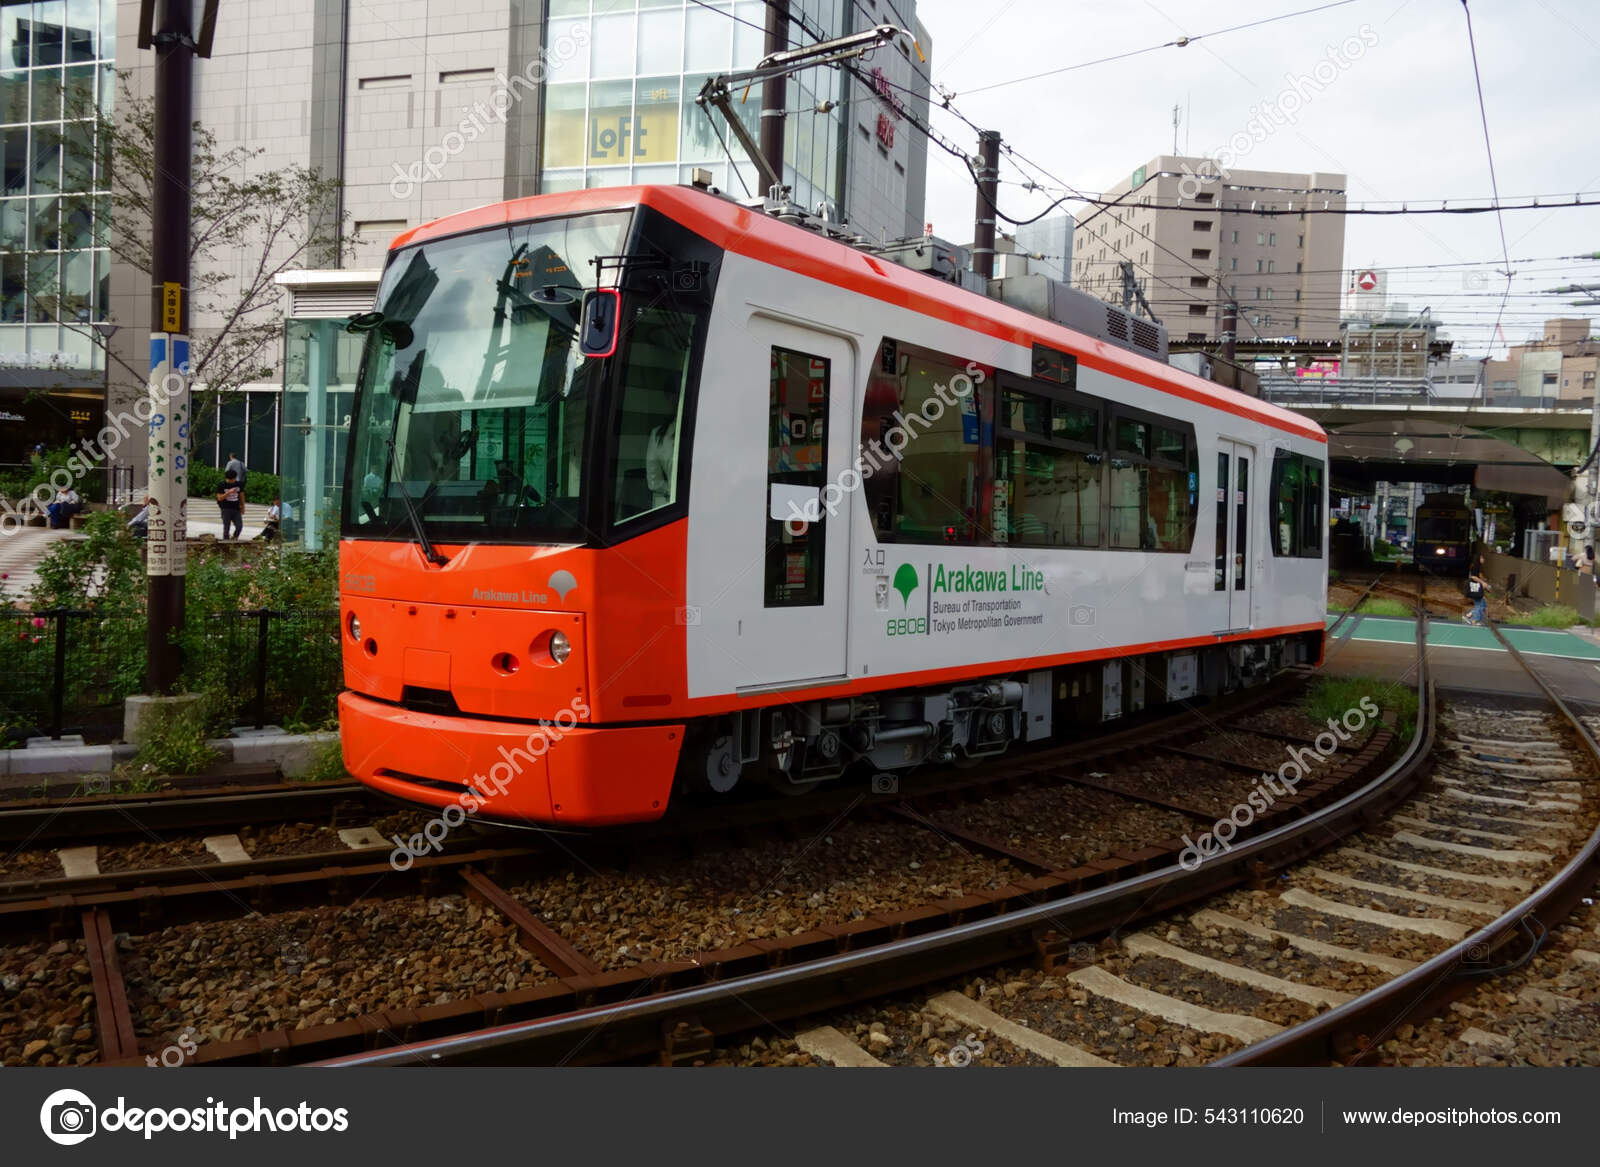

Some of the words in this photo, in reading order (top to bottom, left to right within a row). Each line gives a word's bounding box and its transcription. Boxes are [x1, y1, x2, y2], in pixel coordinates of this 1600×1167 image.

[863, 549, 885, 566] 入口
[933, 563, 1007, 593] Arakawa
[1012, 563, 1044, 592] Line
[472, 587, 519, 603] Arakawa
[522, 590, 548, 604] Line
[933, 601, 961, 614] Bureau
[962, 600, 971, 613] of
[971, 599, 1021, 614] Transportation
[887, 617, 926, 636] 8808
[932, 619, 956, 634] Tokyo
[957, 616, 1002, 632] Metropolitan
[1003, 614, 1043, 627] Government
